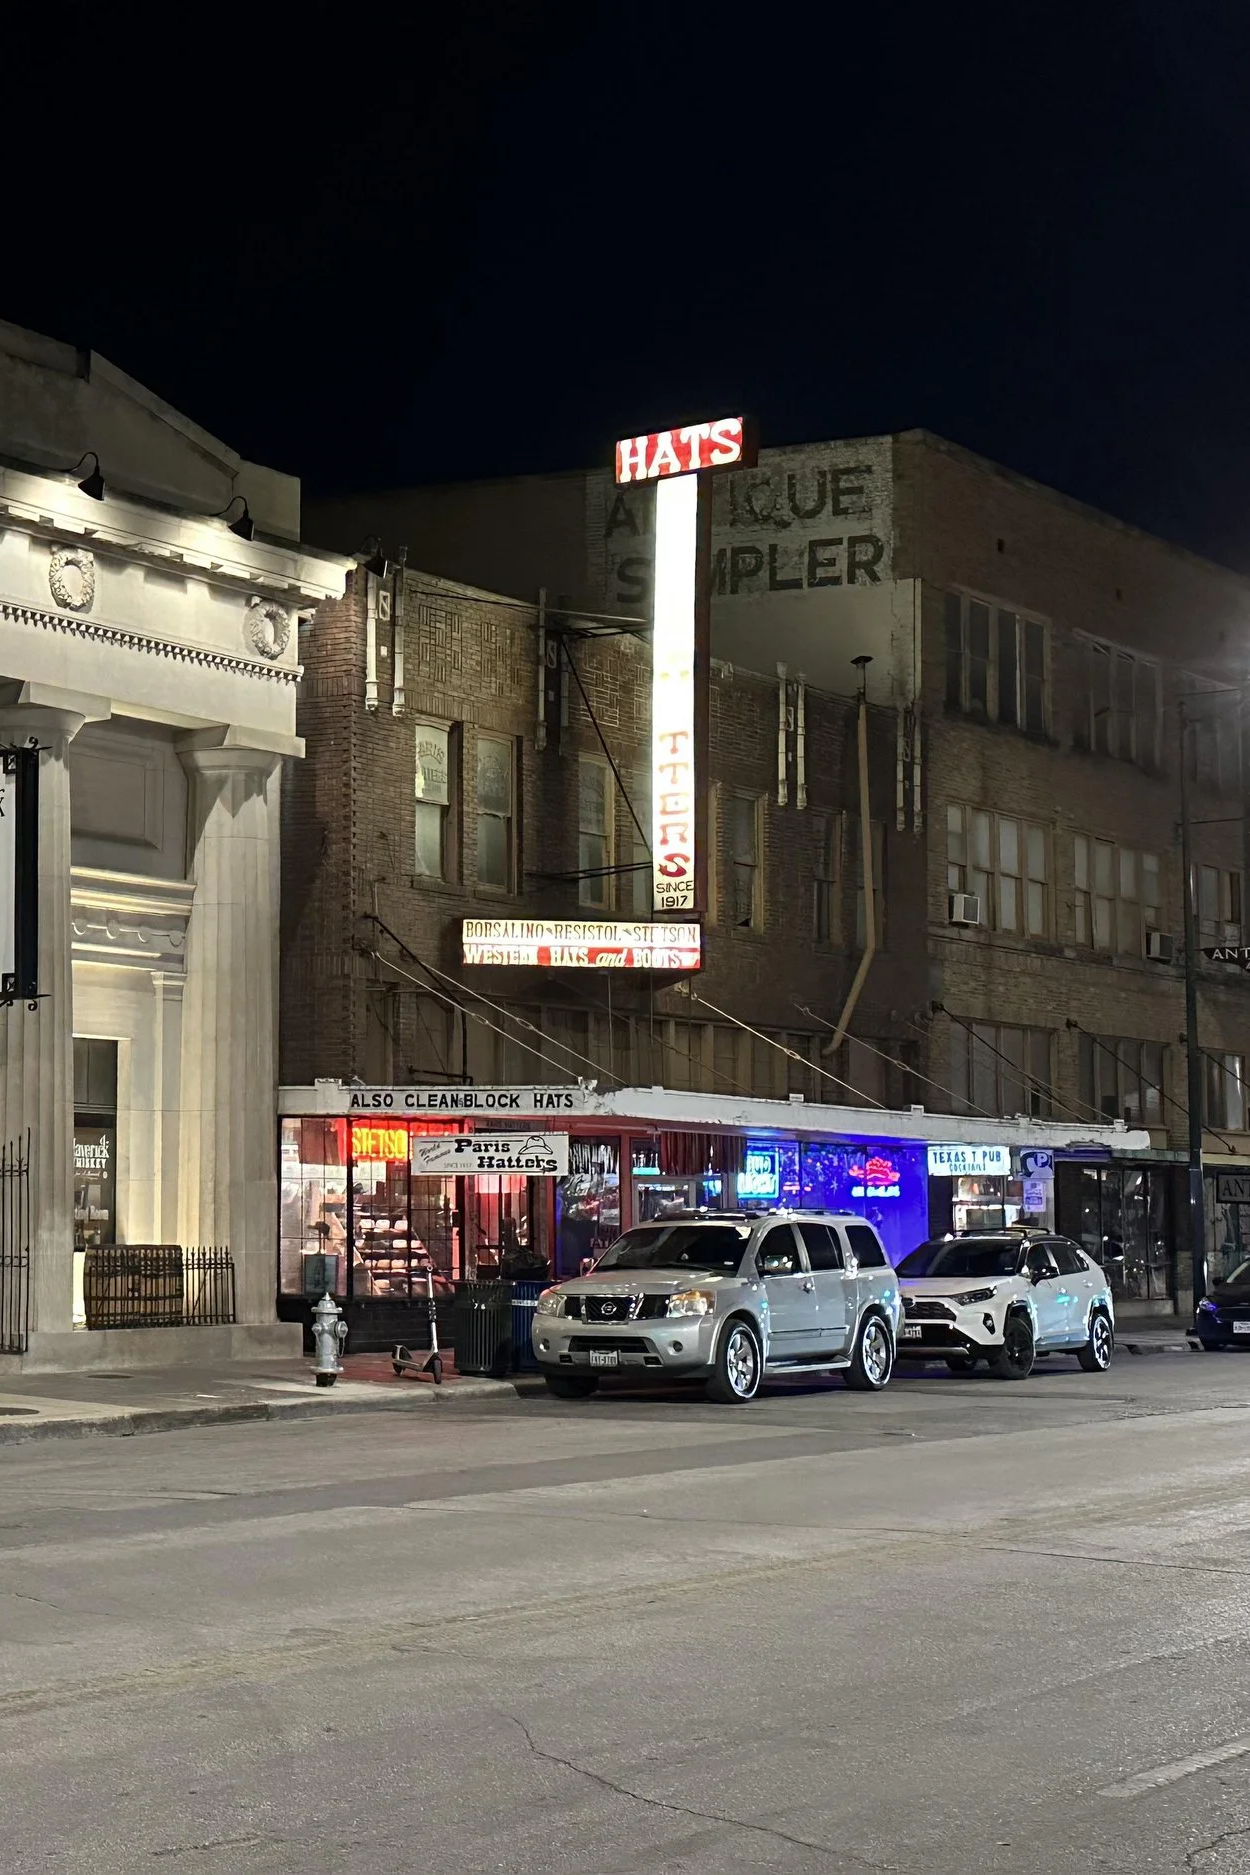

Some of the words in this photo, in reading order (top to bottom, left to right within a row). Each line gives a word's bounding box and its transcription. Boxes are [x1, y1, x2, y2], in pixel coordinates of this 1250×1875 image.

[618, 418, 742, 482] HATS
[605, 465, 872, 538] AIQUE
[616, 534, 884, 603] SPLER
[658, 668, 691, 878] TTERS
[656, 880, 694, 894] SINCE
[661, 895, 688, 908] 1917
[554, 923, 621, 941] RESISTOL
[633, 925, 696, 943] STETSON
[550, 946, 589, 966] HATS
[596, 948, 629, 967] and
[350, 1093, 393, 1108] ALSO
[533, 1093, 573, 1108] HATS
[73, 1134, 109, 1158] averick
[351, 1127, 408, 1158] STETSO
[454, 1138, 510, 1153] Paris
[74, 1158, 107, 1168] HISKEY
[477, 1156, 558, 1173] Hatters
[933, 1151, 966, 1164] TEXAS
[972, 1151, 977, 1162] T
[983, 1150, 1002, 1162] PUB
